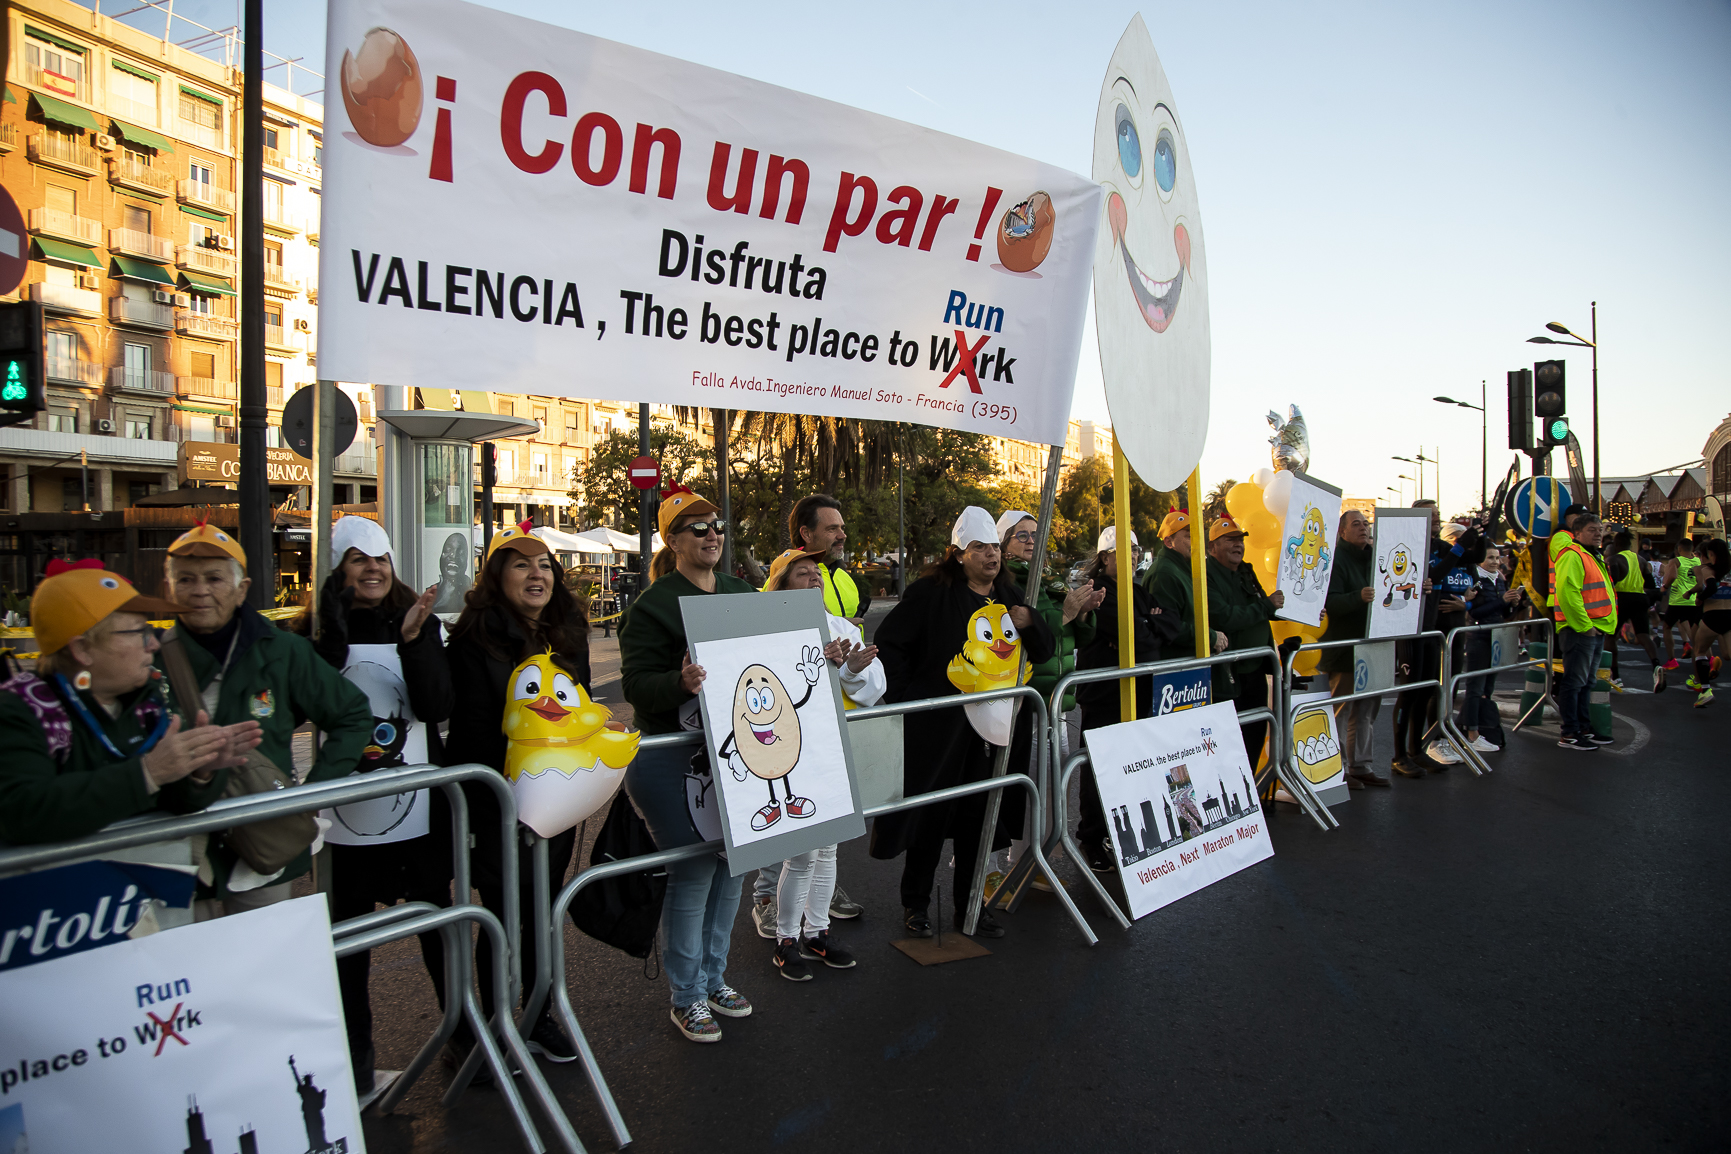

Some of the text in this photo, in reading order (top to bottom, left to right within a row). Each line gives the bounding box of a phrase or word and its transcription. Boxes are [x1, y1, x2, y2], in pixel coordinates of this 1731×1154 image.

[501, 72, 681, 199] Con
[707, 142, 809, 225] un
[824, 172, 958, 253] par
[967, 187, 1002, 262] !
[659, 229, 826, 300] Disfruta
[352, 249, 584, 328] VALENCIA
[620, 290, 687, 339] The
[701, 302, 780, 351] best
[786, 318, 878, 362] place
[889, 331, 918, 367] to
[944, 290, 1004, 333] Run
[693, 371, 724, 388] Falla
[831, 385, 872, 400] Manuel
[876, 390, 902, 404] Soto
[916, 394, 965, 413] Francia
[972, 402, 1017, 425] (395)
[267, 463, 312, 481] BLANCA
[1201, 728, 1212, 737] Run
[1123, 758, 1154, 775] VALENCIA
[1157, 755, 1167, 765] the
[1167, 751, 1180, 762] best
[1181, 748, 1195, 760] place
[1195, 745, 1201, 754] to
[1125, 854, 1139, 864] Tokio
[1137, 860, 1176, 885] Valencia
[1180, 847, 1200, 867] Next
[1203, 835, 1235, 856] Maraton
[1236, 824, 1259, 840] Major
[1146, 846, 1162, 856] Boston
[1166, 836, 1183, 847] London
[135, 978, 192, 1008] Run
[1, 1048, 89, 1094] place
[97, 1037, 127, 1058] to
